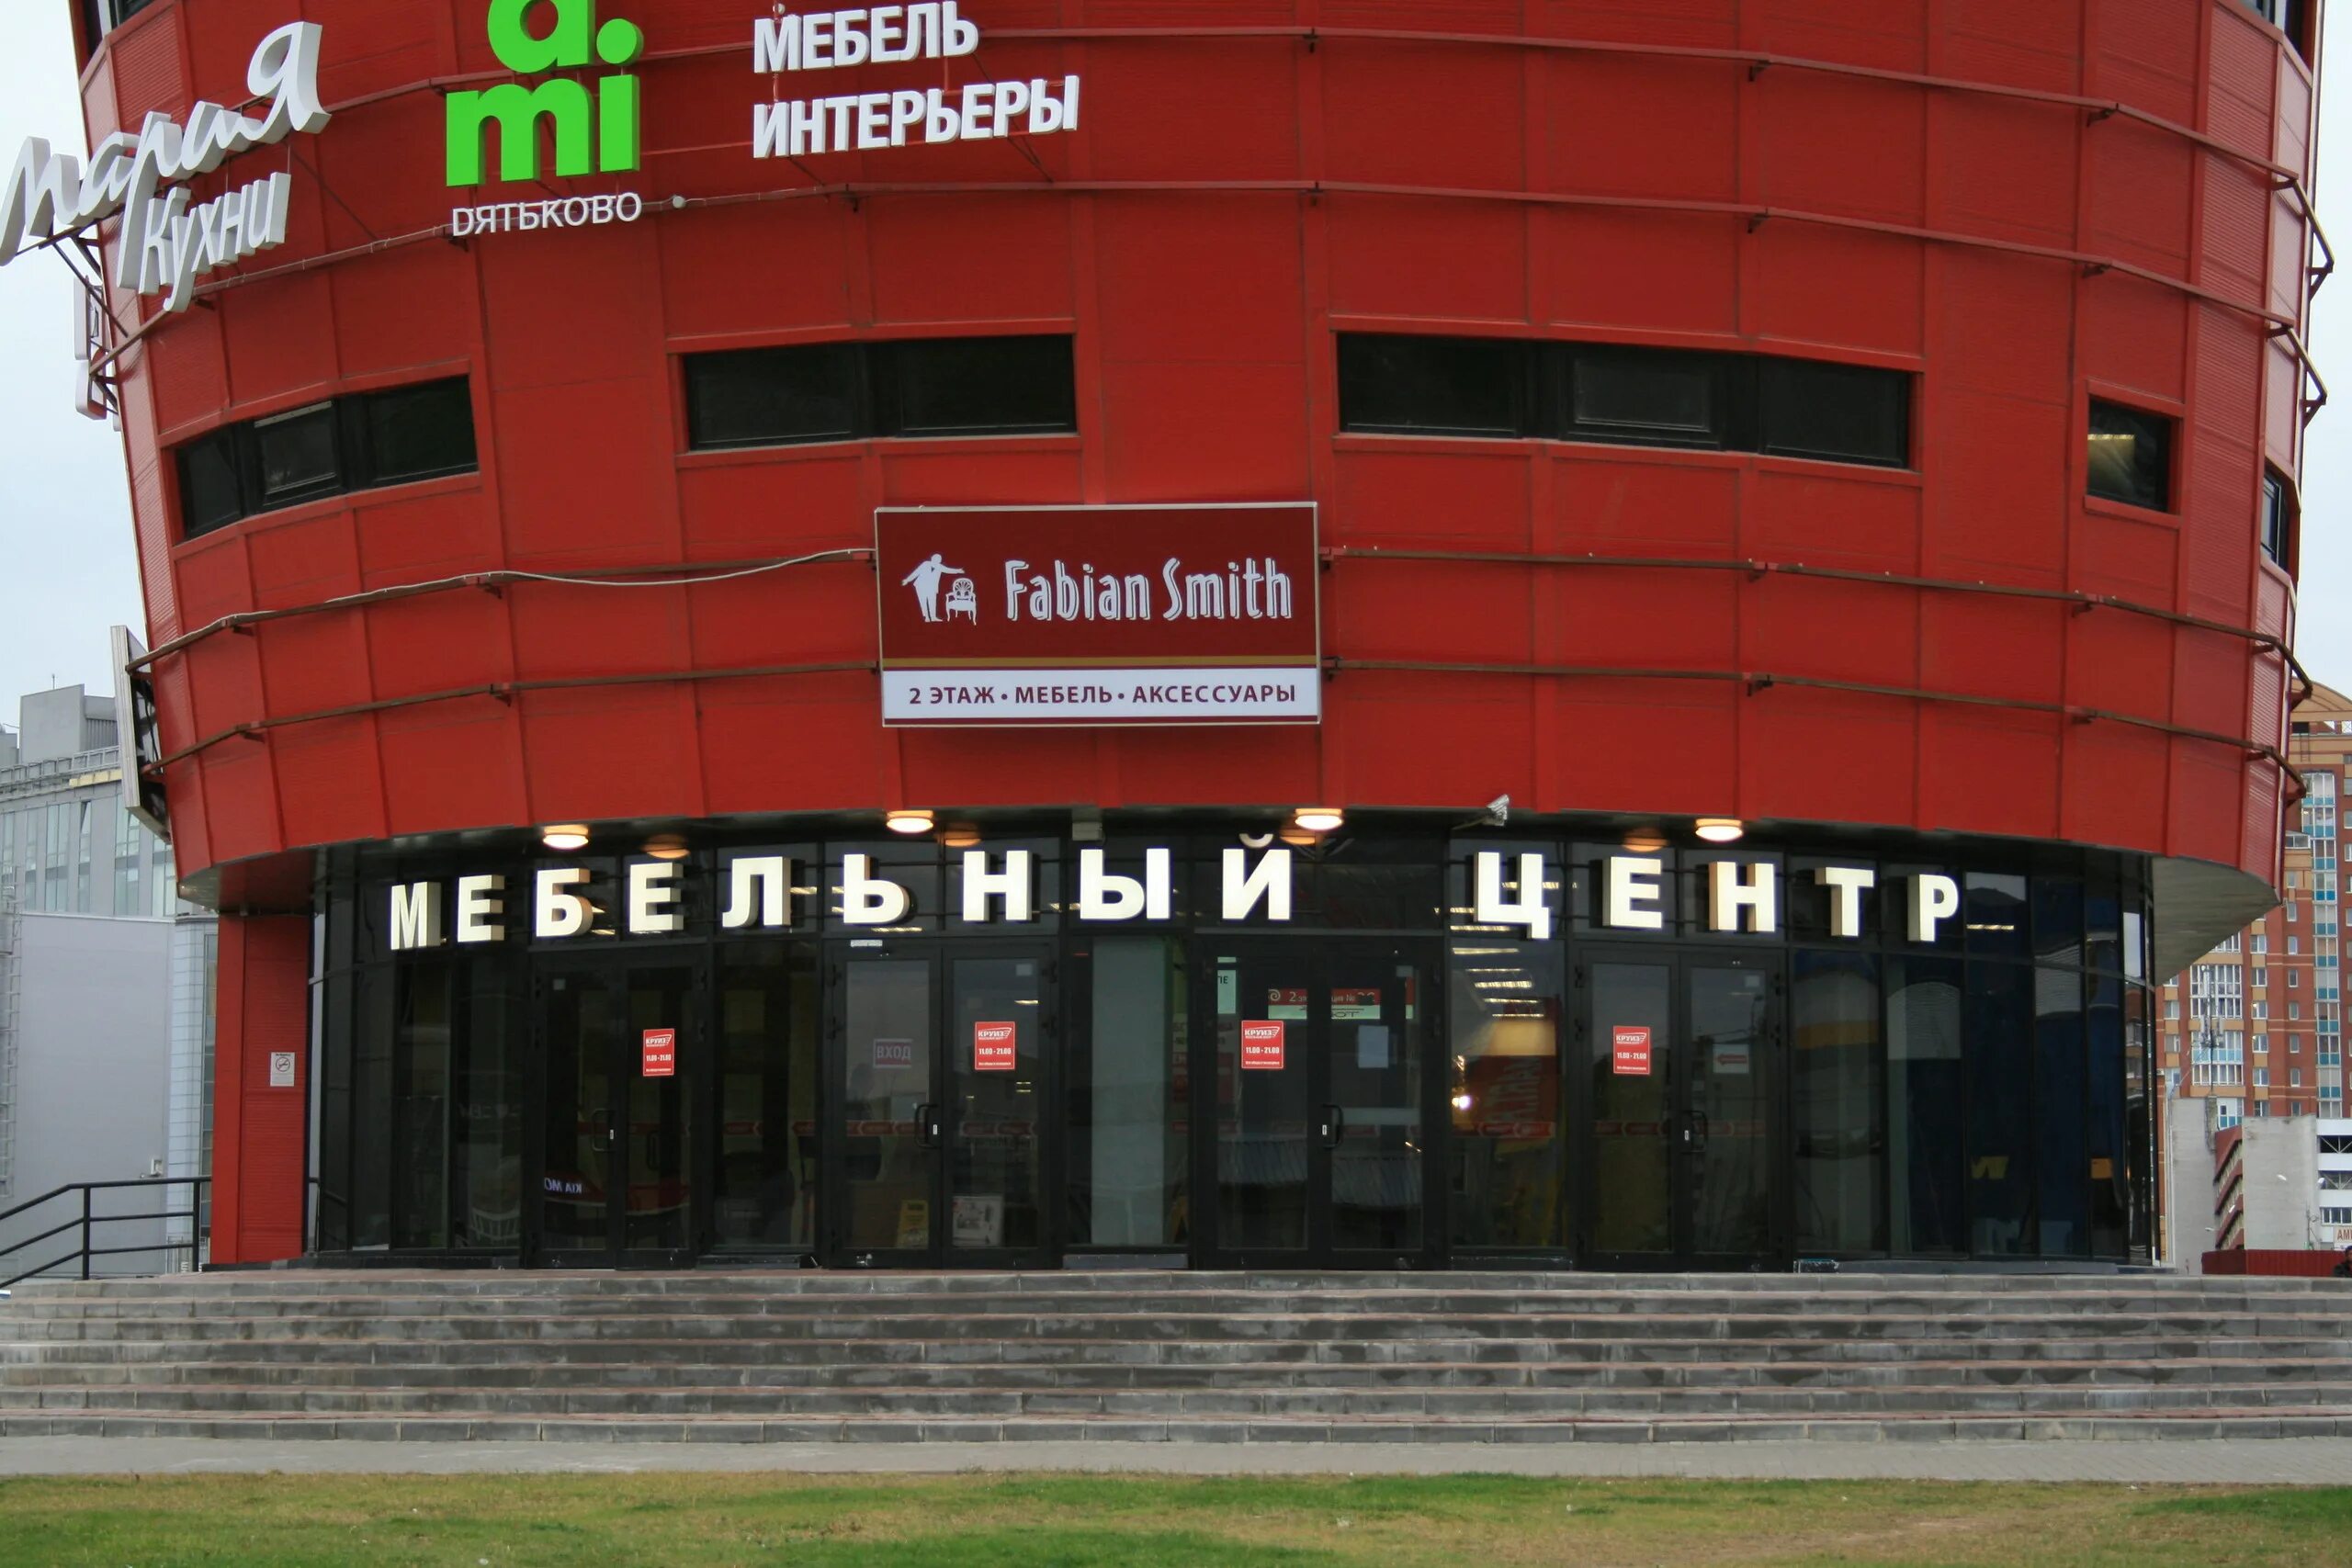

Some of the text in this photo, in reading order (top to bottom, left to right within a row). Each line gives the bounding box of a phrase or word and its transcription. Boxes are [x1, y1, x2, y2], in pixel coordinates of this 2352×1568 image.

[753, 1, 979, 73] МЕБЕЛЬ
[752, 74, 1080, 159] ИНТЕРЬЕРЫ
[1005, 557, 1293, 622] Fabian Smith
[909, 683, 1296, 705] 2 ЭТАЖ МЕБЕЛЬ АКСЕССУАРЫ
[390, 832, 1961, 951] МЕБЕЛЬНЫЙ ЦЕНТР
[876, 1045, 911, 1061] ВХОД
